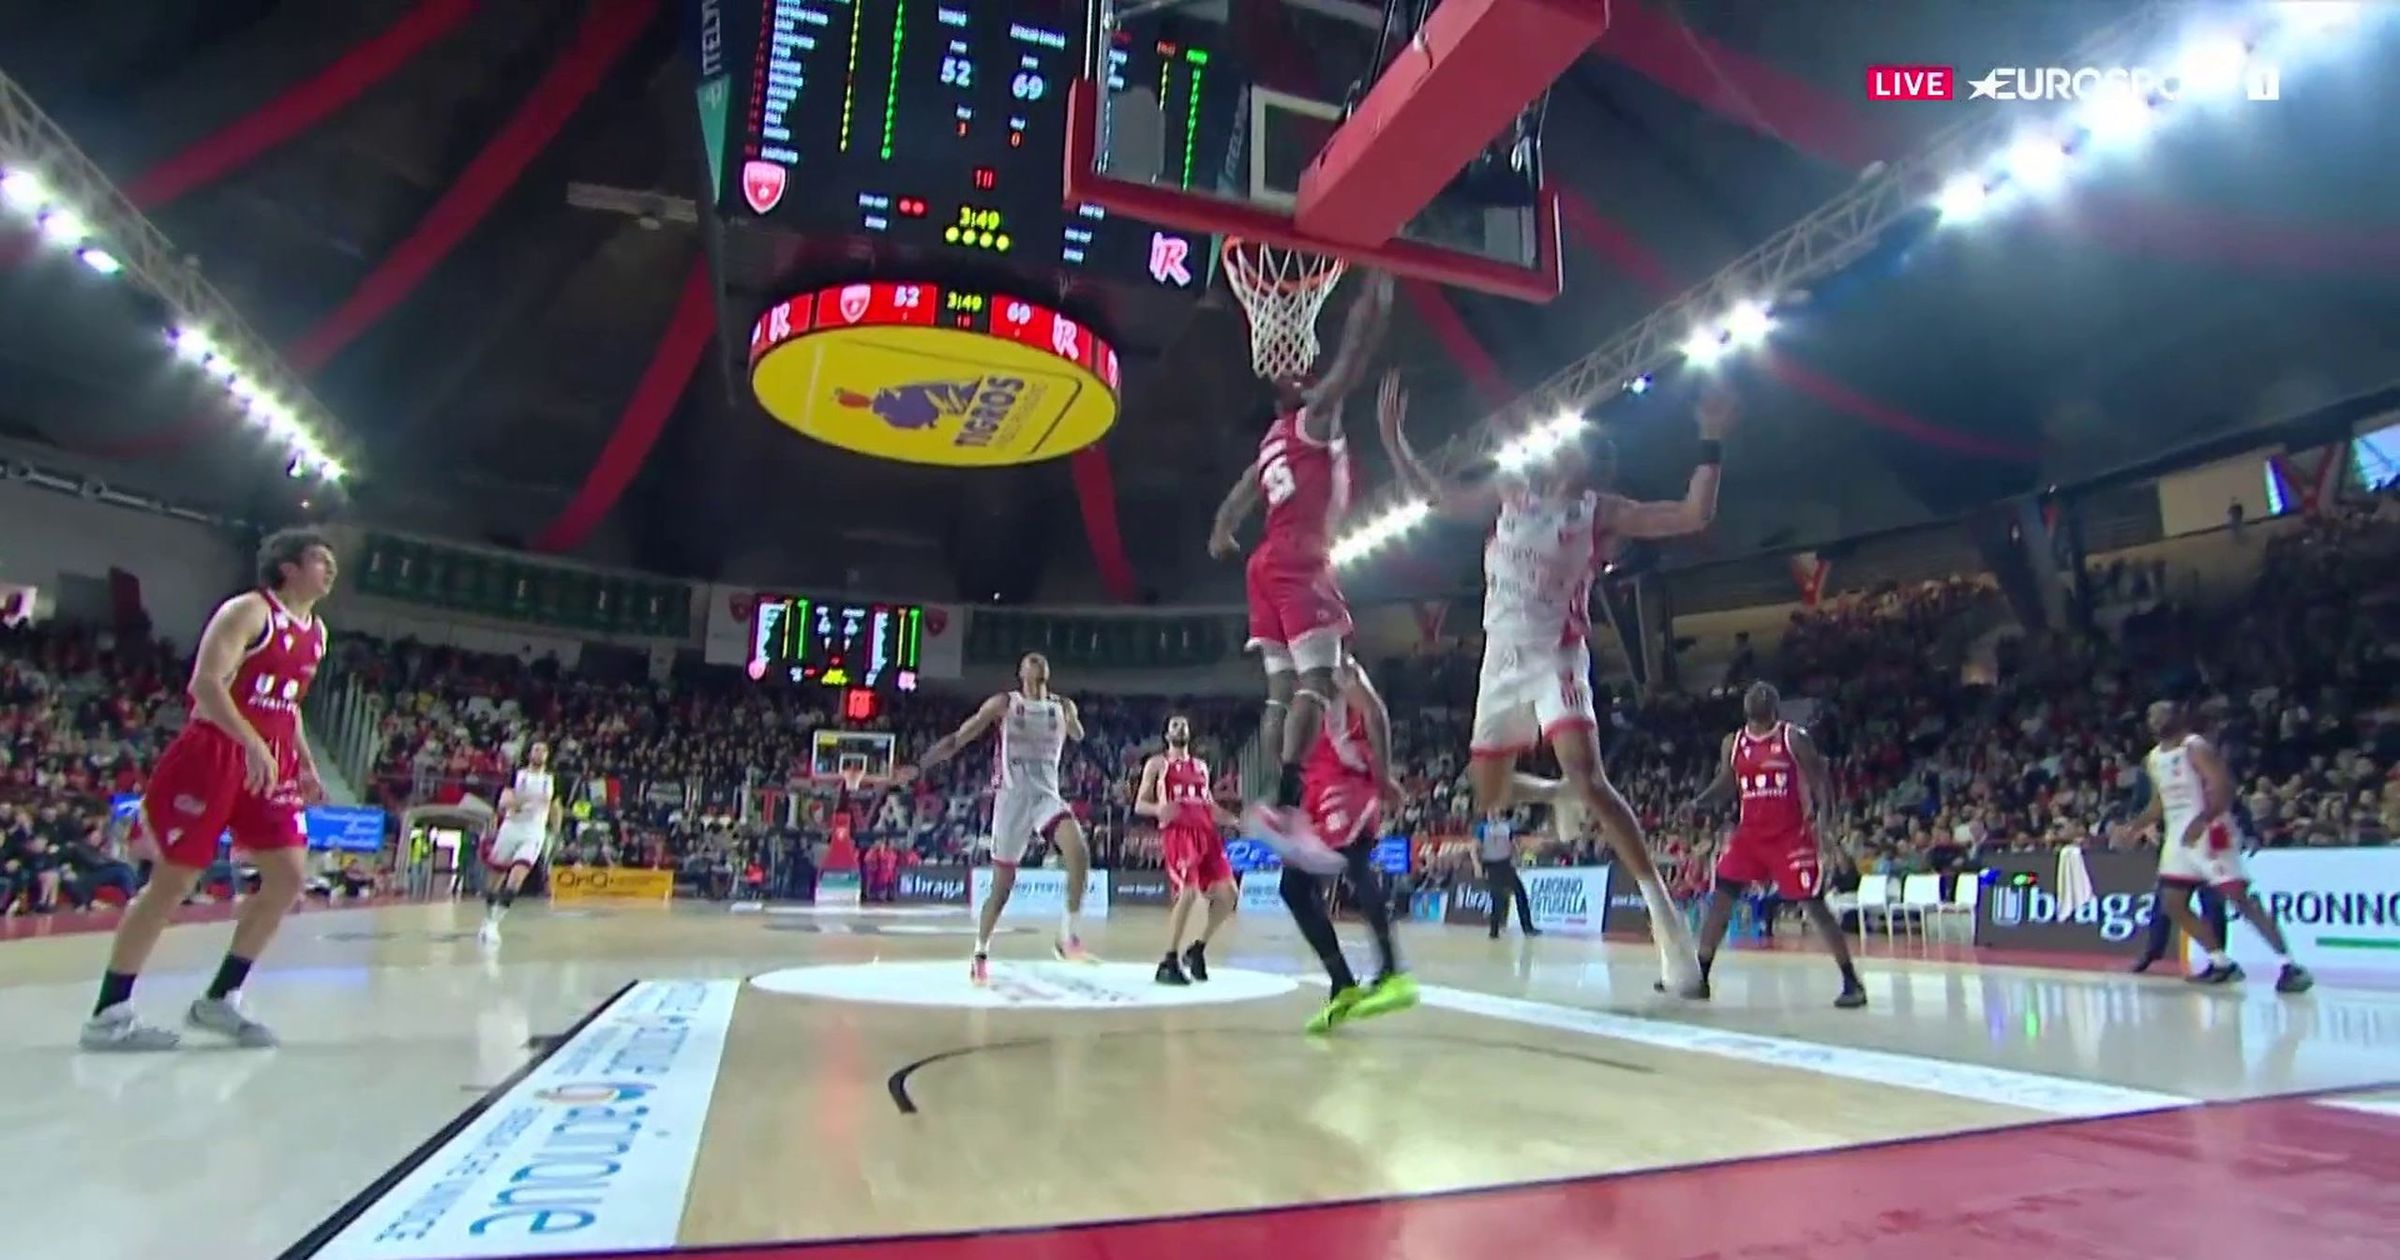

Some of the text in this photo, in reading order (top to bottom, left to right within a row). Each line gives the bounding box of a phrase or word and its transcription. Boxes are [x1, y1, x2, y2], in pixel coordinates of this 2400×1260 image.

[940, 56, 972, 87] 52
[1012, 73, 1044, 100] 69
[893, 285, 920, 308] 52
[914, 874, 964, 899] braga
[2029, 886, 2154, 942] baga
